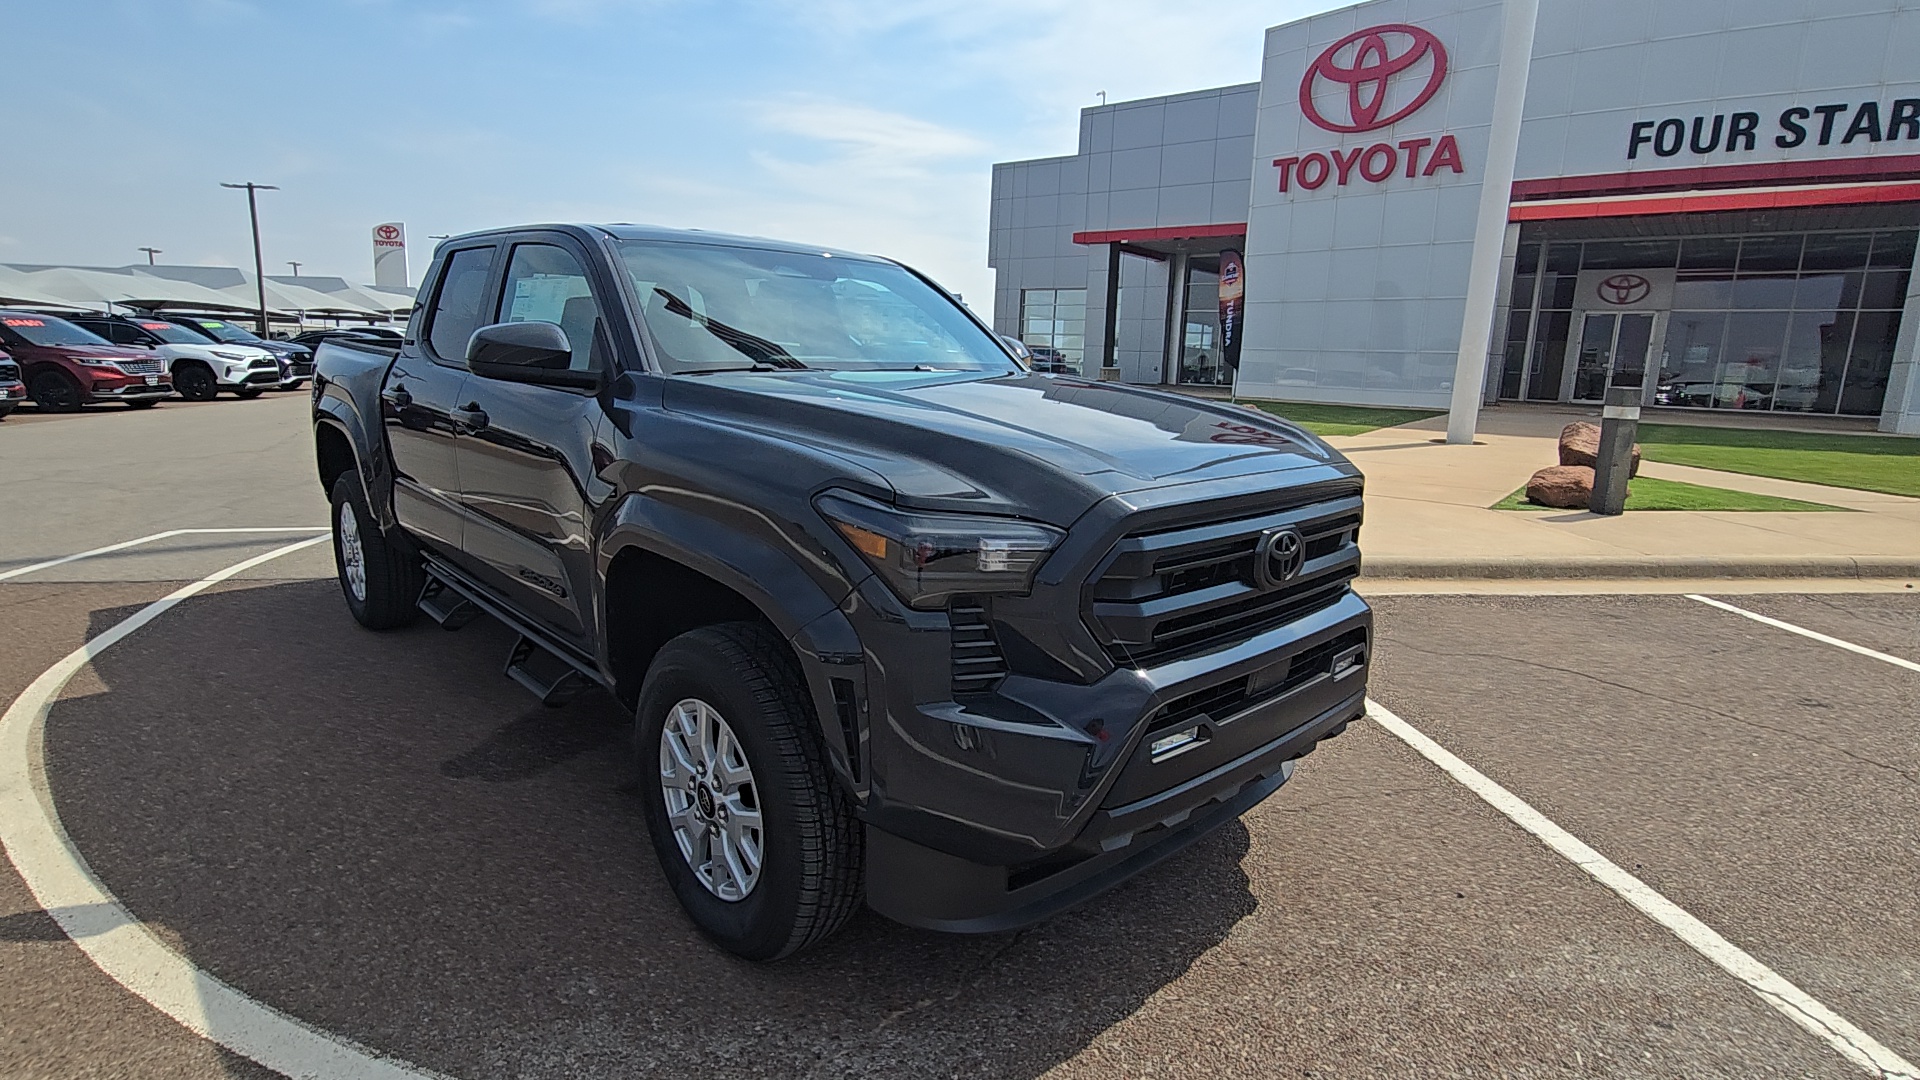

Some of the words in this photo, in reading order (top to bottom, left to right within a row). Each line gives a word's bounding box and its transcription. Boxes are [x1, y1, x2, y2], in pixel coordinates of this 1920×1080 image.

[1627, 111, 1760, 160] FOUR
[1775, 98, 1920, 149] STAR
[1273, 134, 1464, 193] TOYOTA
[1224, 300, 1235, 347] TUNDRA
